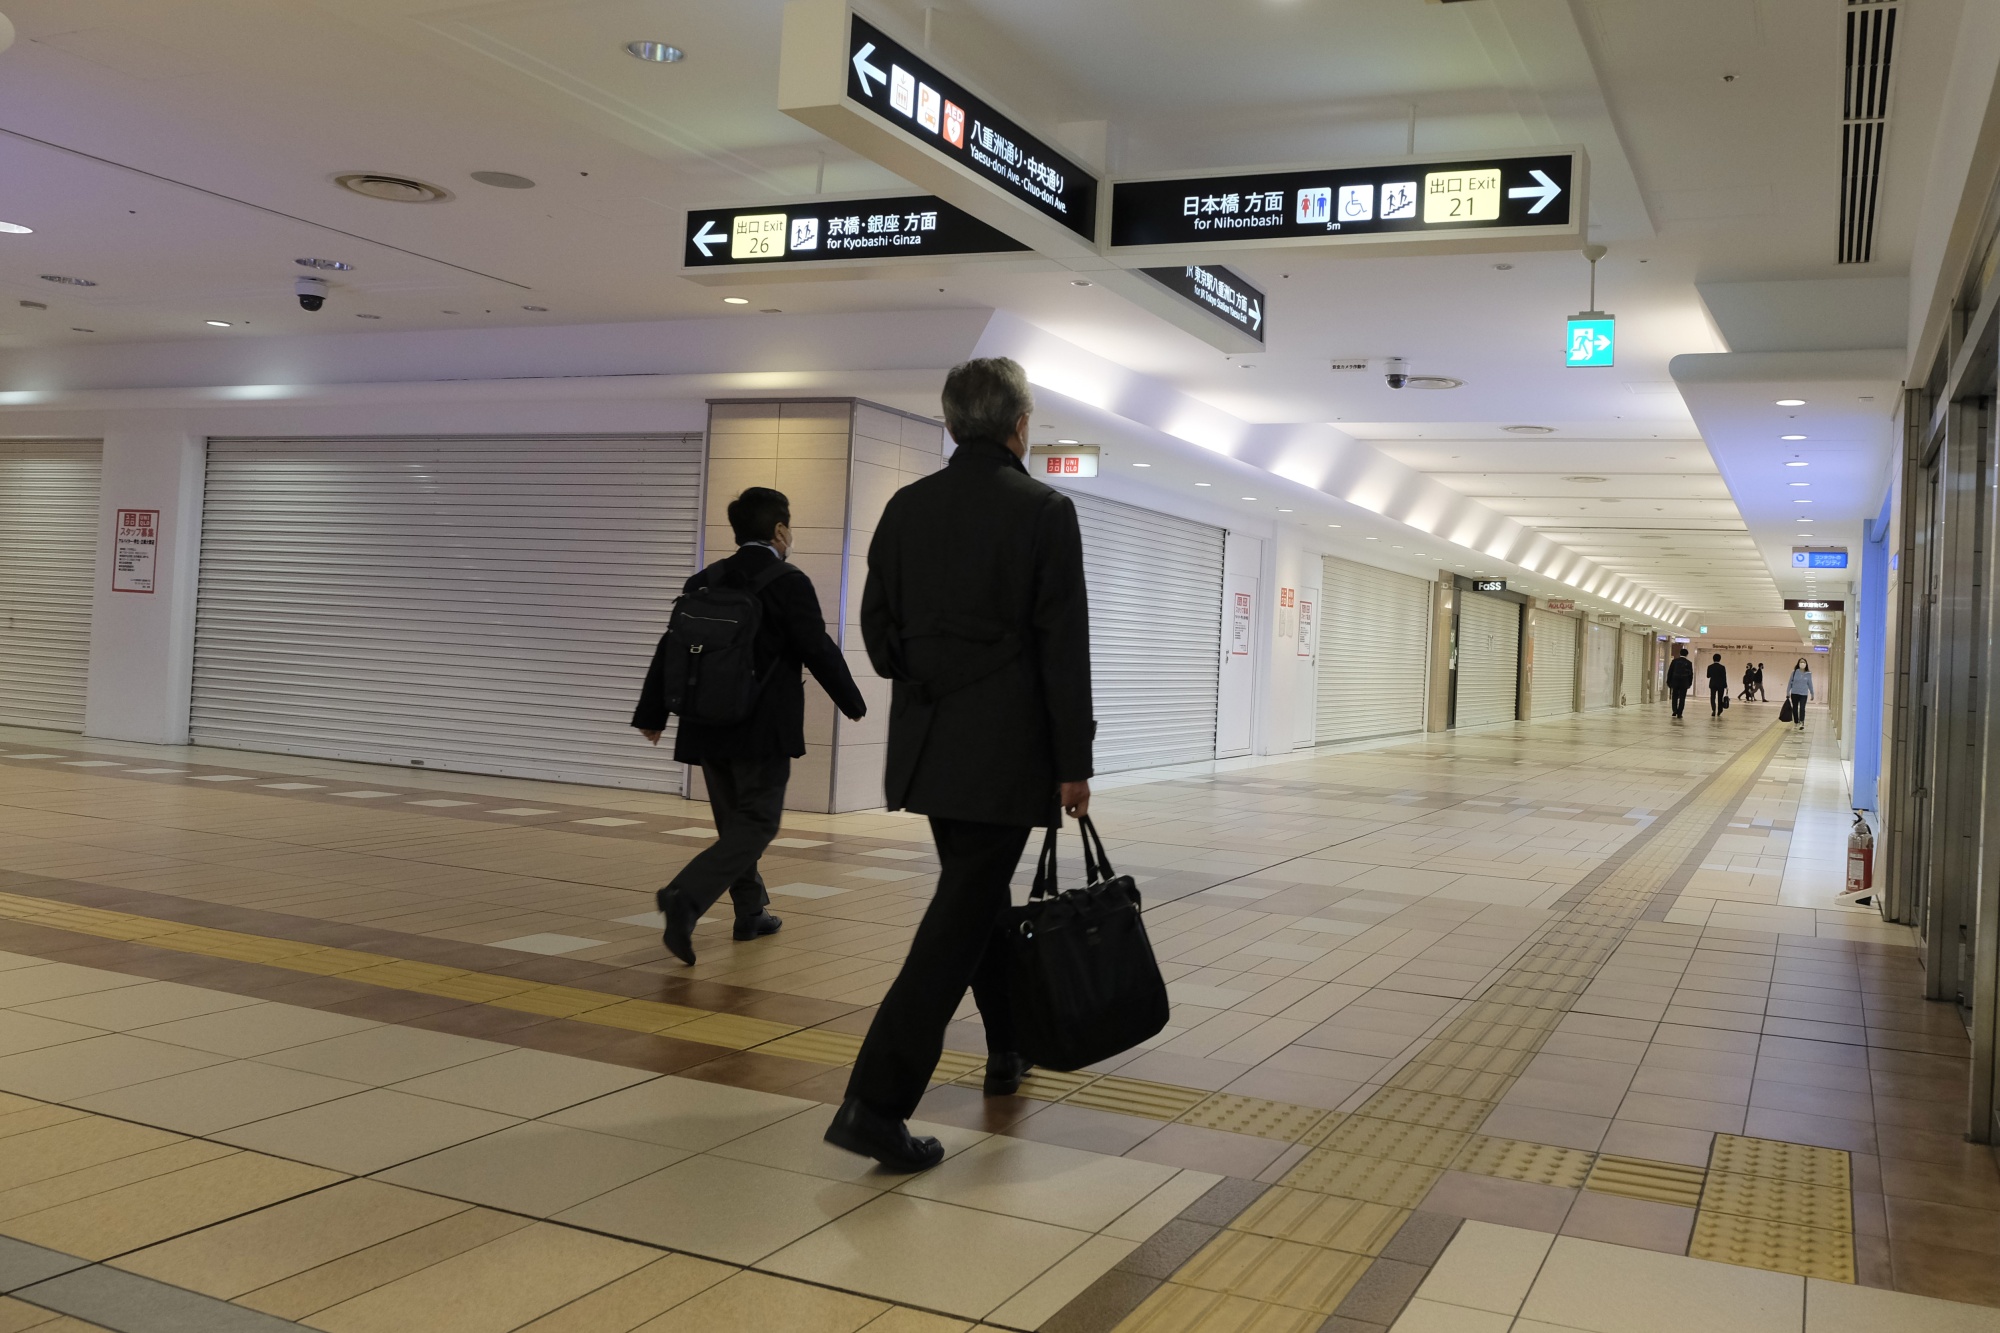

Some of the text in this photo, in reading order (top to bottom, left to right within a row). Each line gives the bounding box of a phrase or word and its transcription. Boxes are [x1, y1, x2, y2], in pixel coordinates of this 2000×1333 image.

[944, 103, 963, 123] AED
[970, 143, 1007, 177] Yaesu-dori
[1054, 197, 1067, 214] Ave.
[1430, 176, 1496, 194] 出口 Exit
[1183, 191, 1284, 216] 日本橋 方面
[1449, 197, 1474, 217] 21
[736, 220, 783, 235] 出口 Exit
[827, 211, 937, 236] 京橋・銀座 方面
[1194, 214, 1283, 230] for Nihonbashi
[1326, 222, 1341, 231] 5m
[749, 238, 769, 254] 26
[827, 237, 841, 249] for
[1236, 292, 1248, 312] 方面
[1478, 582, 1502, 590] FaSS
